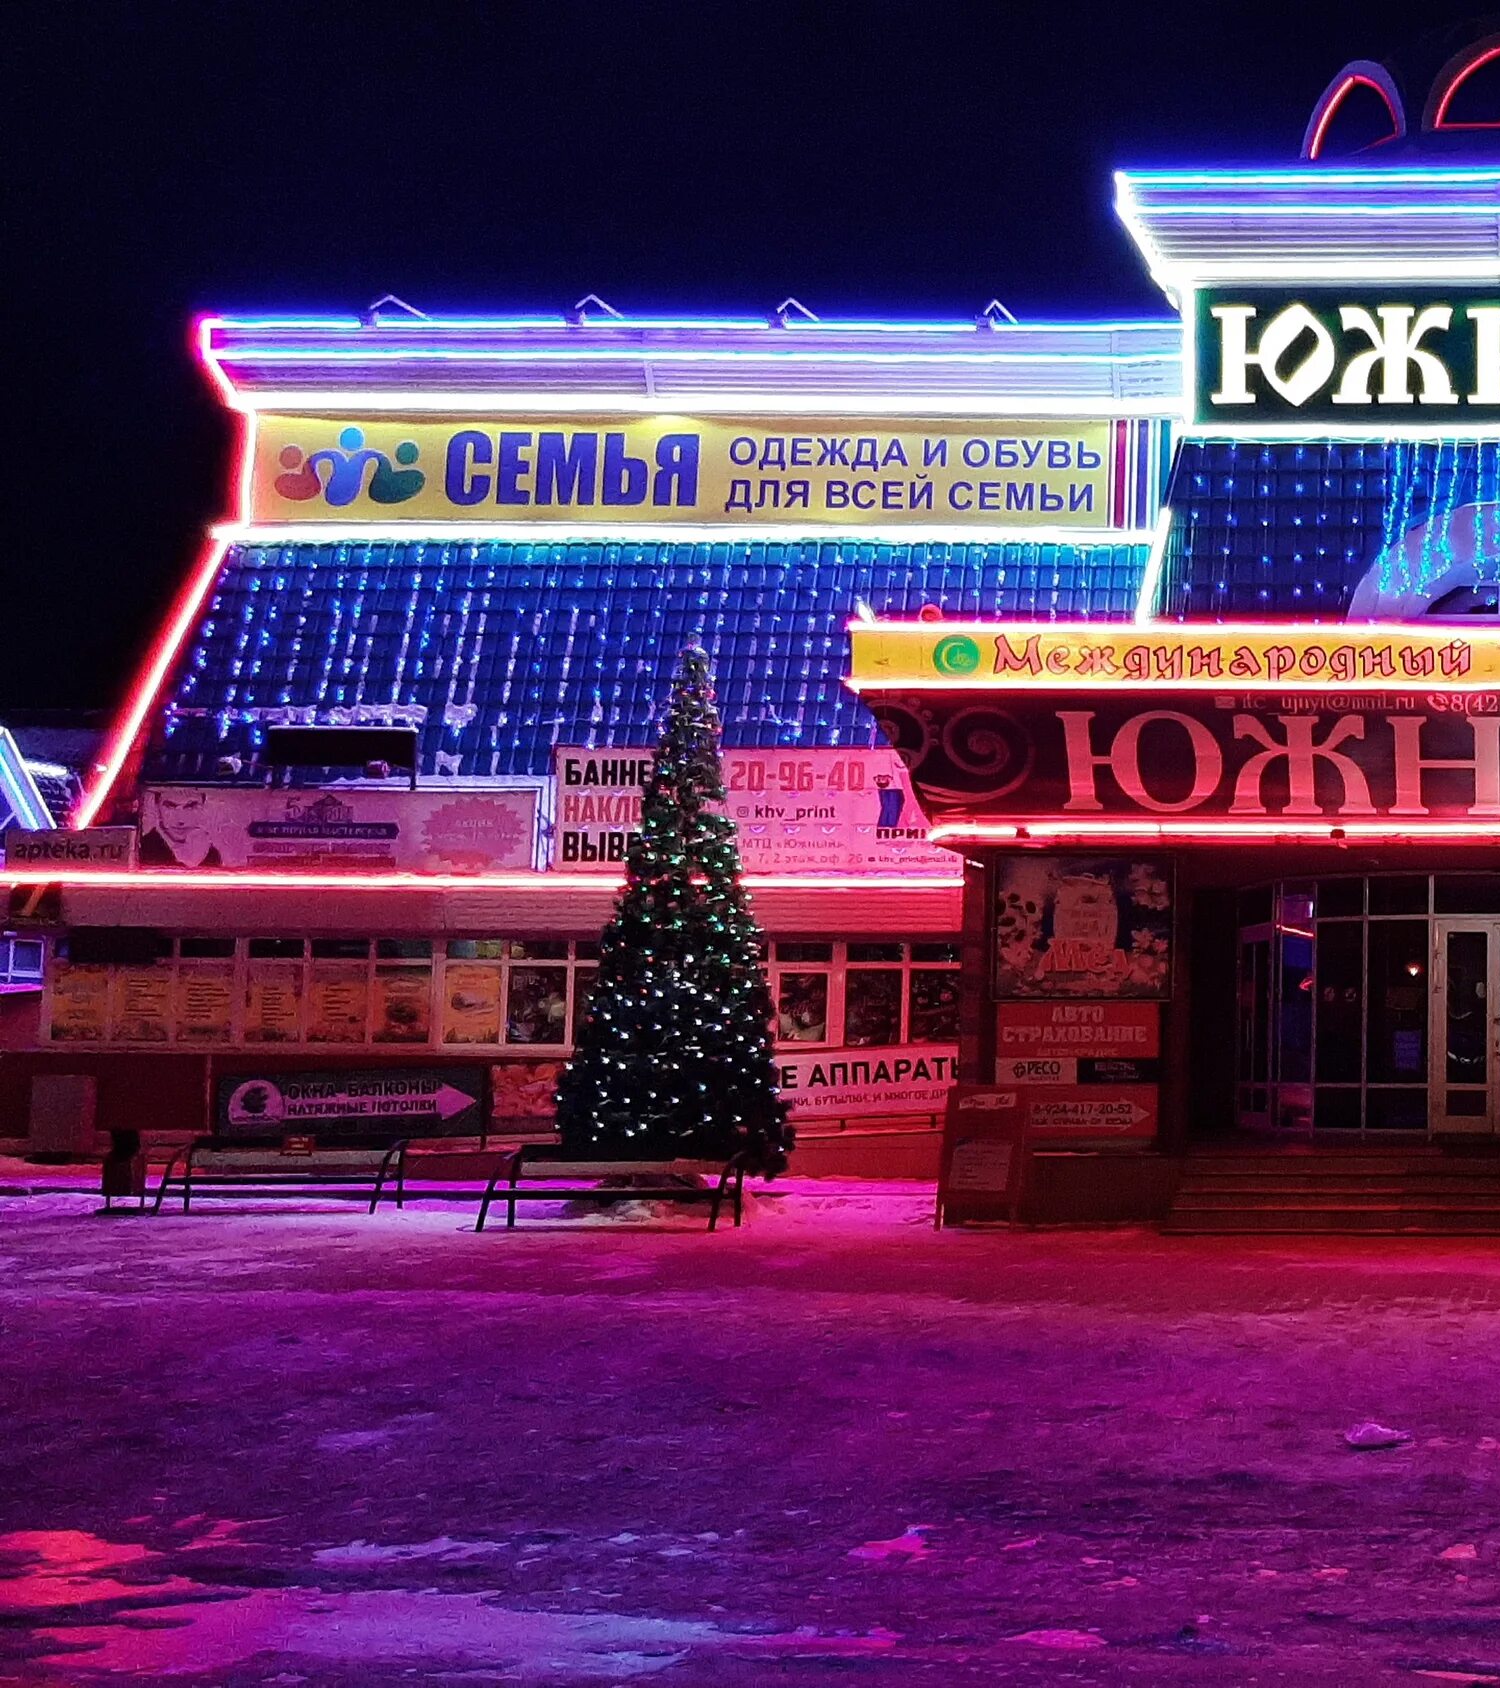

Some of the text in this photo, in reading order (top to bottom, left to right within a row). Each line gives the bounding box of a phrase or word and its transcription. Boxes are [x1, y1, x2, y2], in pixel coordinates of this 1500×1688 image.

[729, 436, 1101, 472] ОДЕЖДА И ОБУВЬ
[444, 429, 700, 506] СЕМЬЯ
[724, 474, 1094, 513] ДЛЯ ВСЕЙ СЕМЬИ
[993, 634, 1472, 683] Международный
[730, 760, 865, 792] 20-96-40
[754, 803, 836, 824] khv_print
[15, 839, 126, 862] apteka.ru
[1051, 1005, 1105, 1023] АВТО
[1002, 1025, 1148, 1043] СТРАХОВАНИЕ
[288, 1080, 438, 1100] ОКНА БАЛКОНЫ
[287, 1099, 437, 1115] НАТЯЖНЫЕ ПОТОЛКИ
